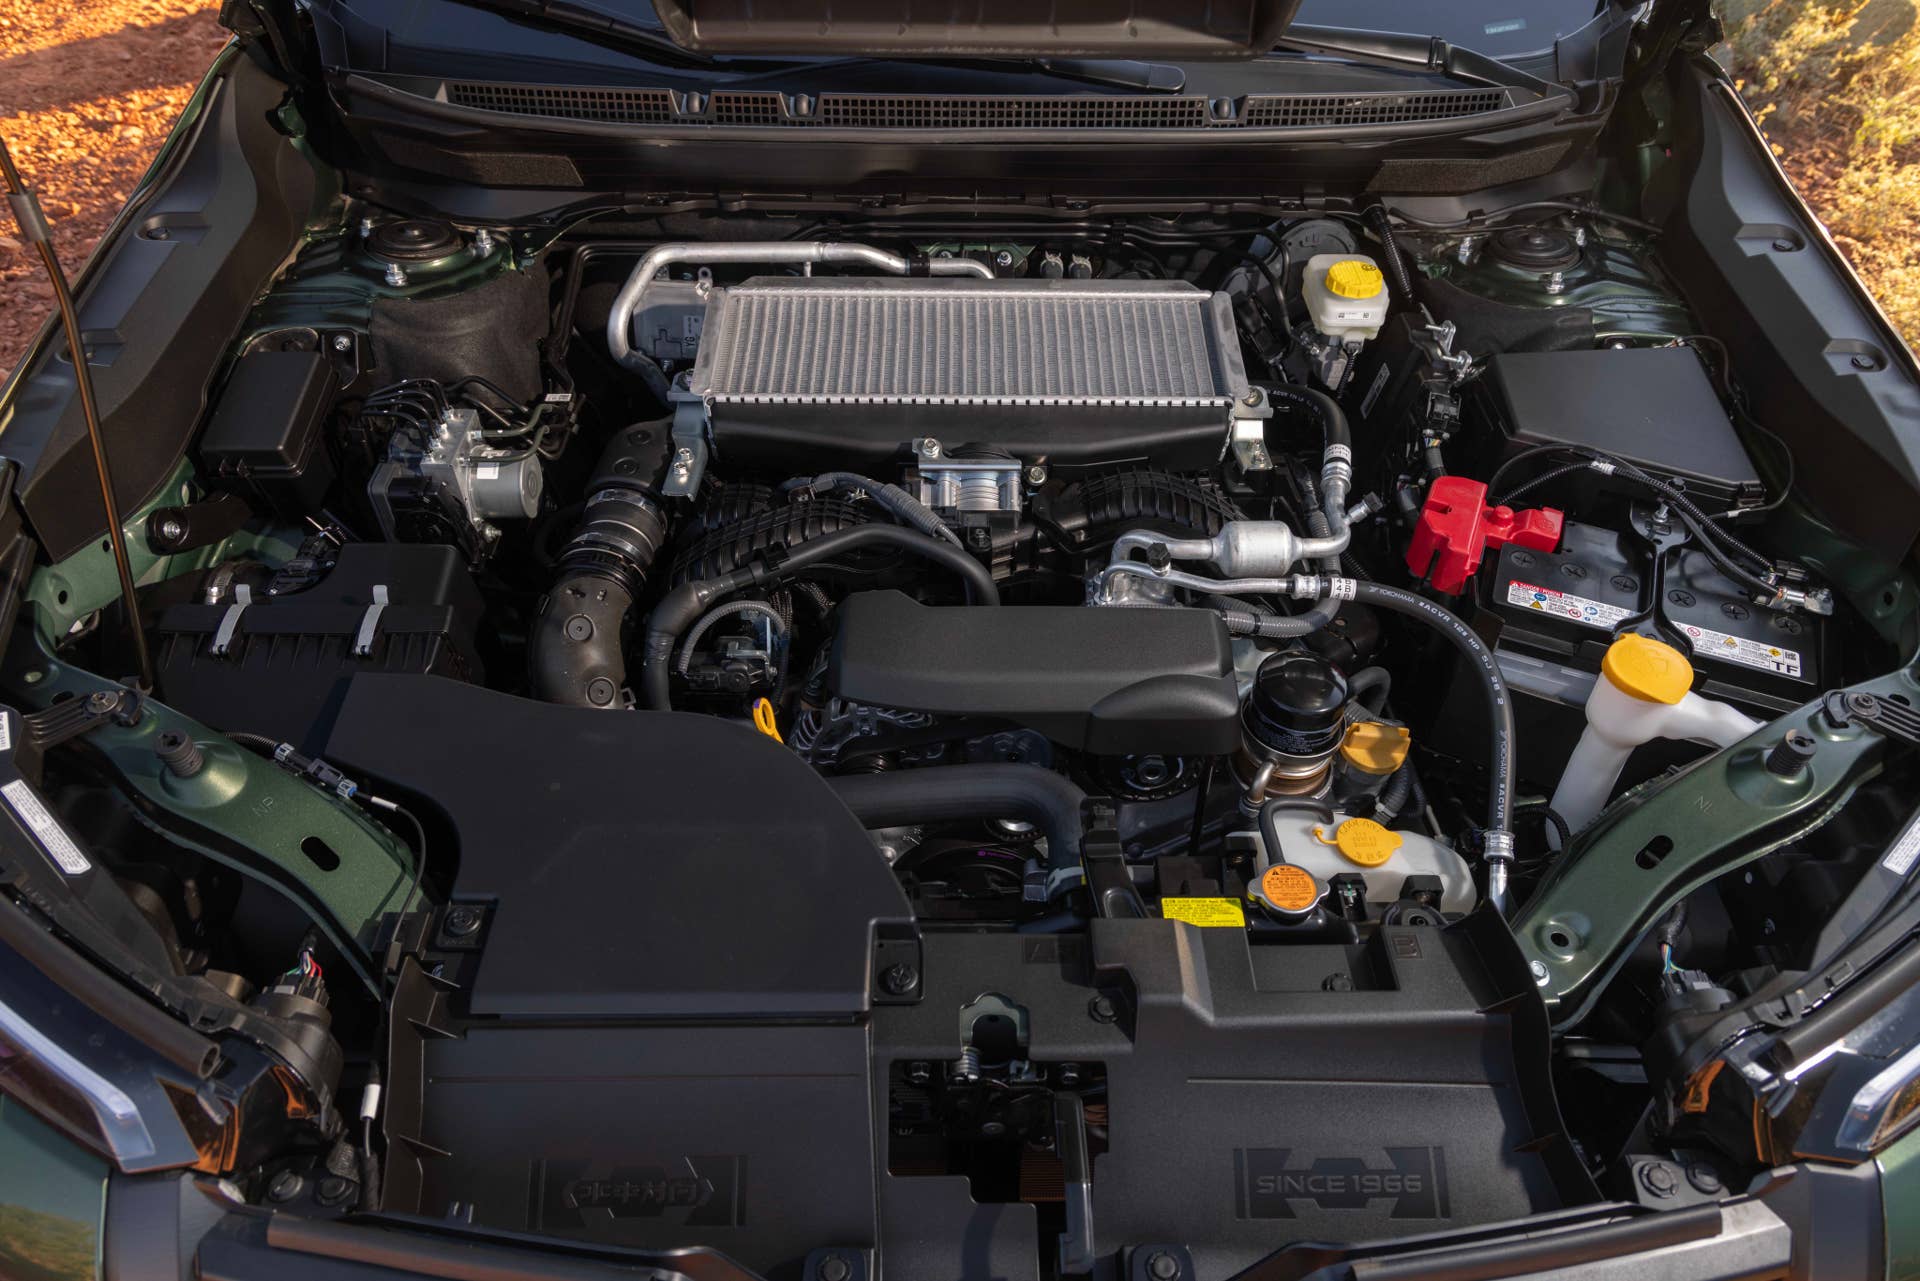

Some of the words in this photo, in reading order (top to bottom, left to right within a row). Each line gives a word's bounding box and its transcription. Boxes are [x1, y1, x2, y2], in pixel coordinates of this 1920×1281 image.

[1378, 588, 1415, 604] YOKOHAMA
[1468, 638, 1480, 650] HP
[1771, 660, 1799, 674] TF
[1255, 1174, 1346, 1194] SINCE
[1351, 1174, 1423, 1194] 1966
